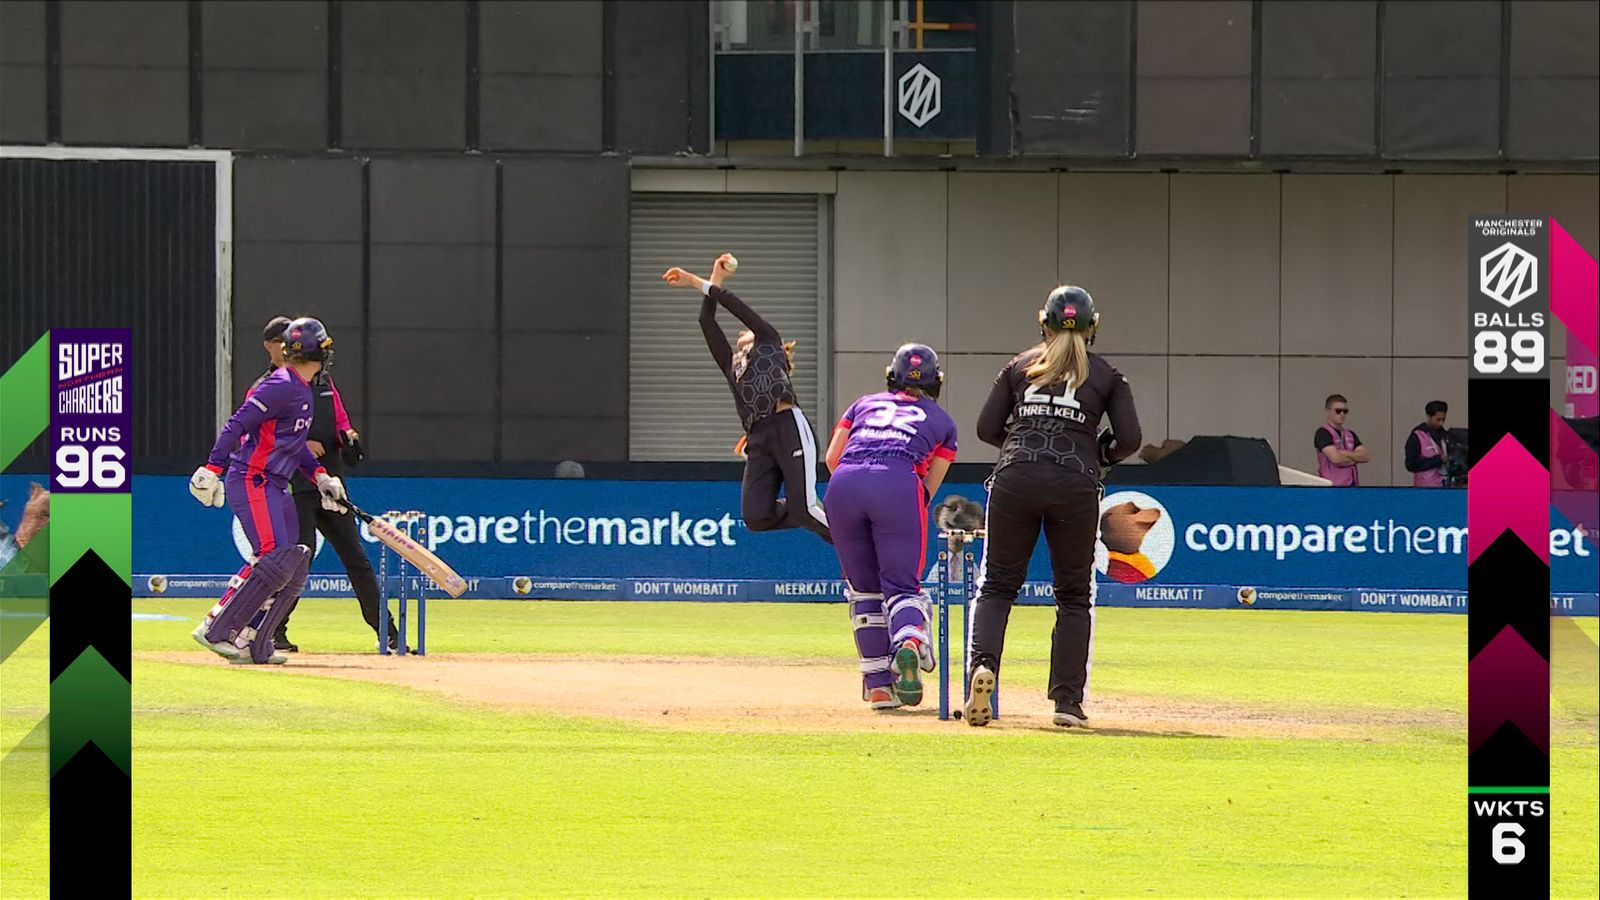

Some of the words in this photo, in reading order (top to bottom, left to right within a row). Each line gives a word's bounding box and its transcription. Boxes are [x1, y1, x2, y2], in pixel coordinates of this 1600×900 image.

[864, 400, 928, 435] 32
[1018, 404, 1087, 424] THRELKELD
[310, 579, 354, 592] WOMBA
[533, 580, 618, 591] comparethemarket
[634, 581, 671, 594] DON'T
[673, 582, 724, 595] WOMBAT
[727, 584, 738, 595] IT
[774, 583, 828, 595] MEERKAT
[830, 583, 842, 595] IT
[1136, 587, 1190, 600] MEERKAT
[1193, 589, 1204, 600] IT
[1360, 592, 1397, 606] DON'T
[1400, 594, 1453, 607] WOMBAT
[1457, 595, 1468, 607] IT
[1562, 597, 1575, 609] IT
